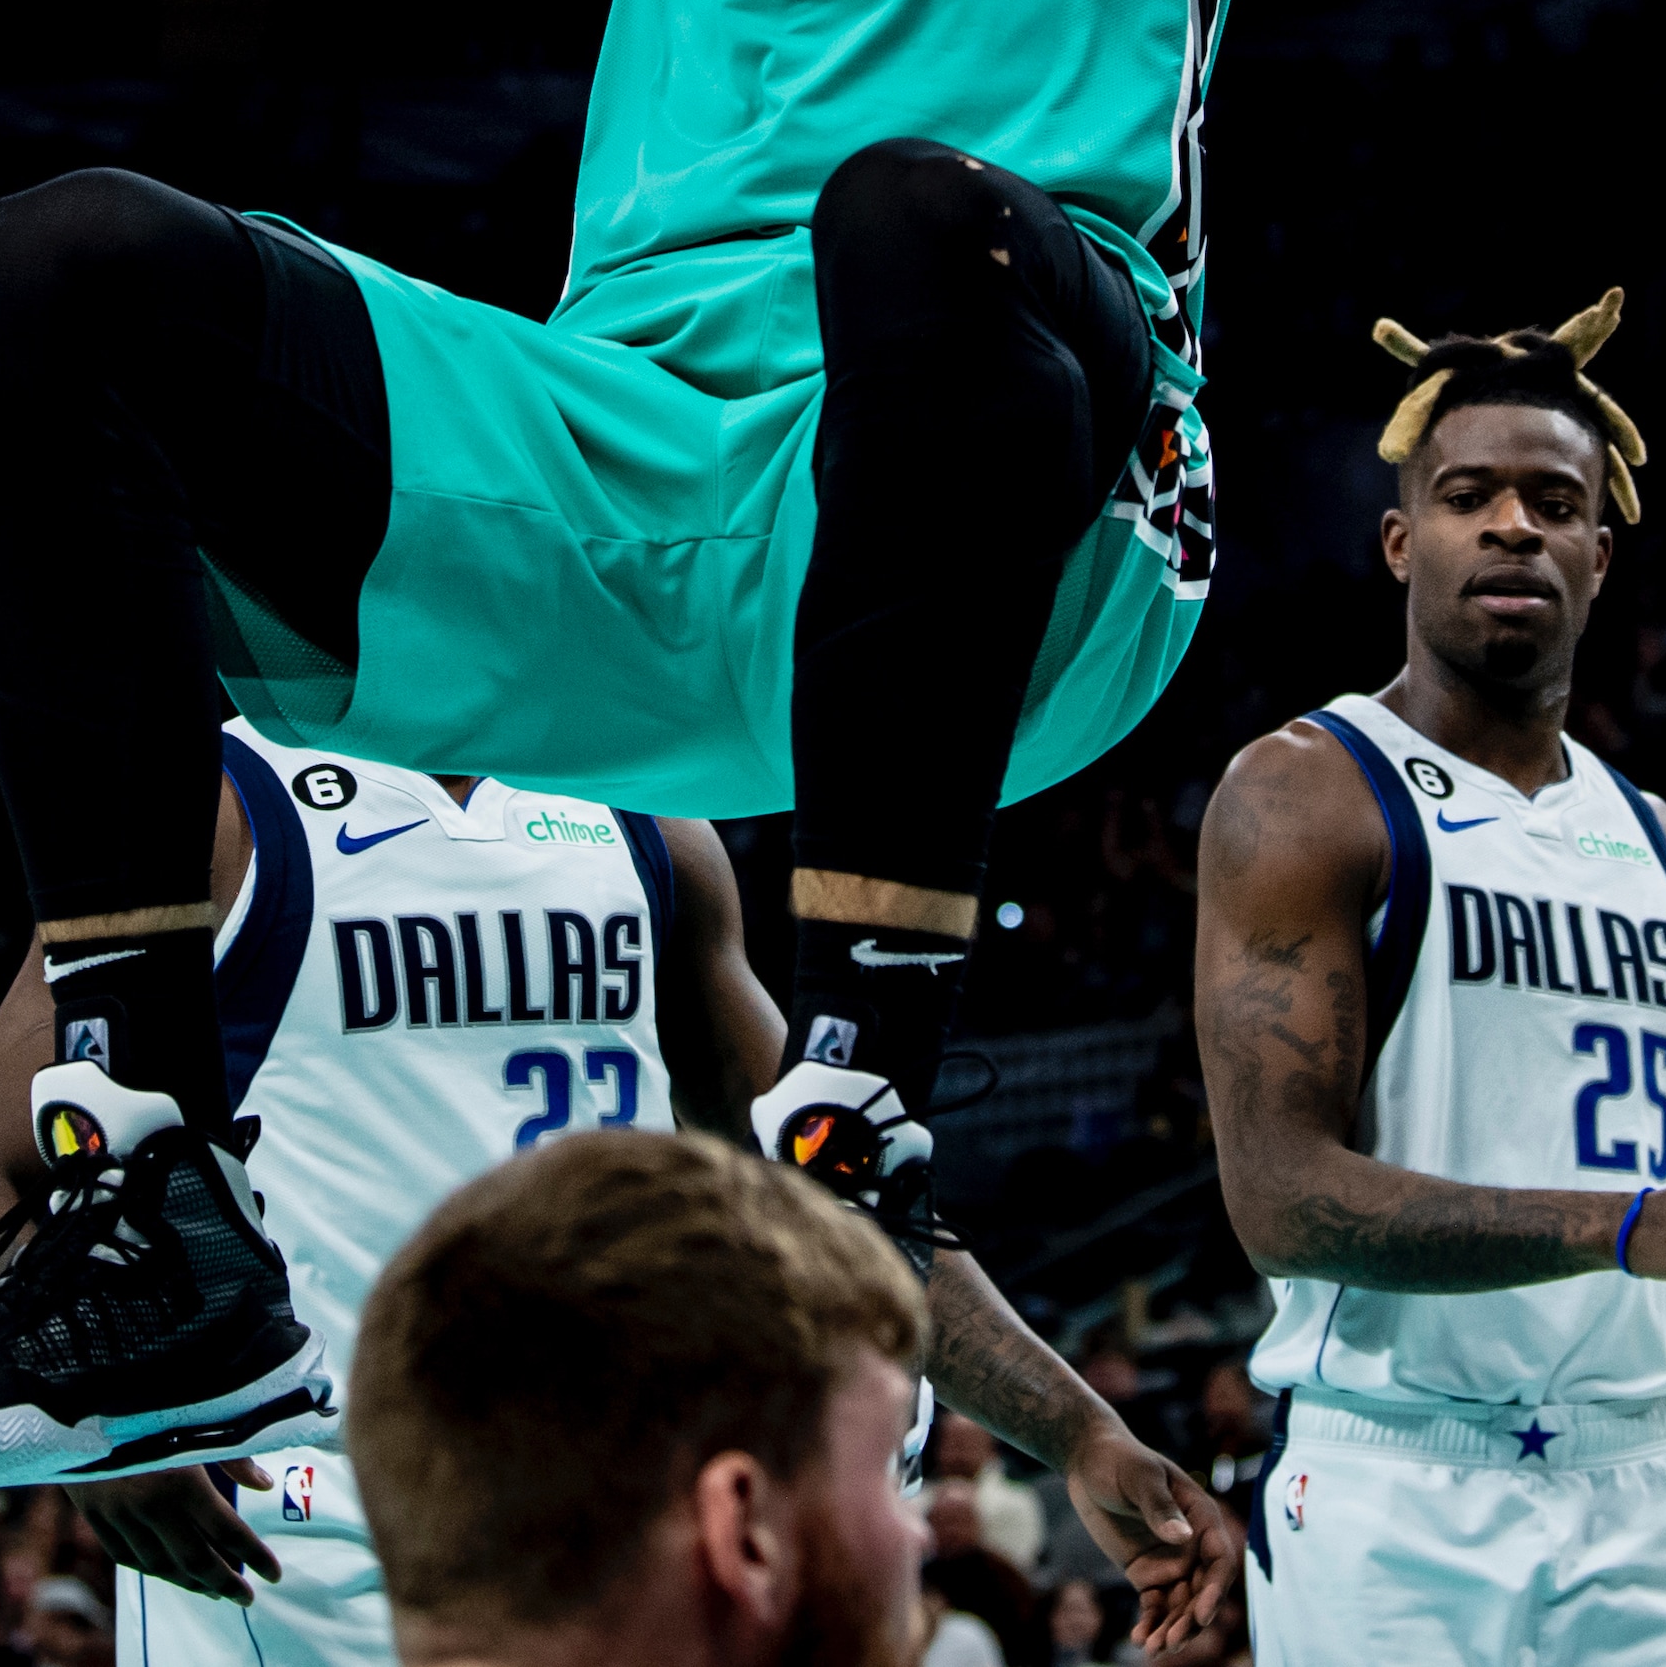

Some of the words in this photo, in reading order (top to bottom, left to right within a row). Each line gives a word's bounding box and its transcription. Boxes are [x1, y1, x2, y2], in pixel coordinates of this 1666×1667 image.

[305, 769, 345, 806] 6
[1413, 758, 1447, 796] 6
[526, 811, 616, 845] chime
[1578, 831, 1652, 866] chime
[330, 907, 645, 1034] DALLAS
